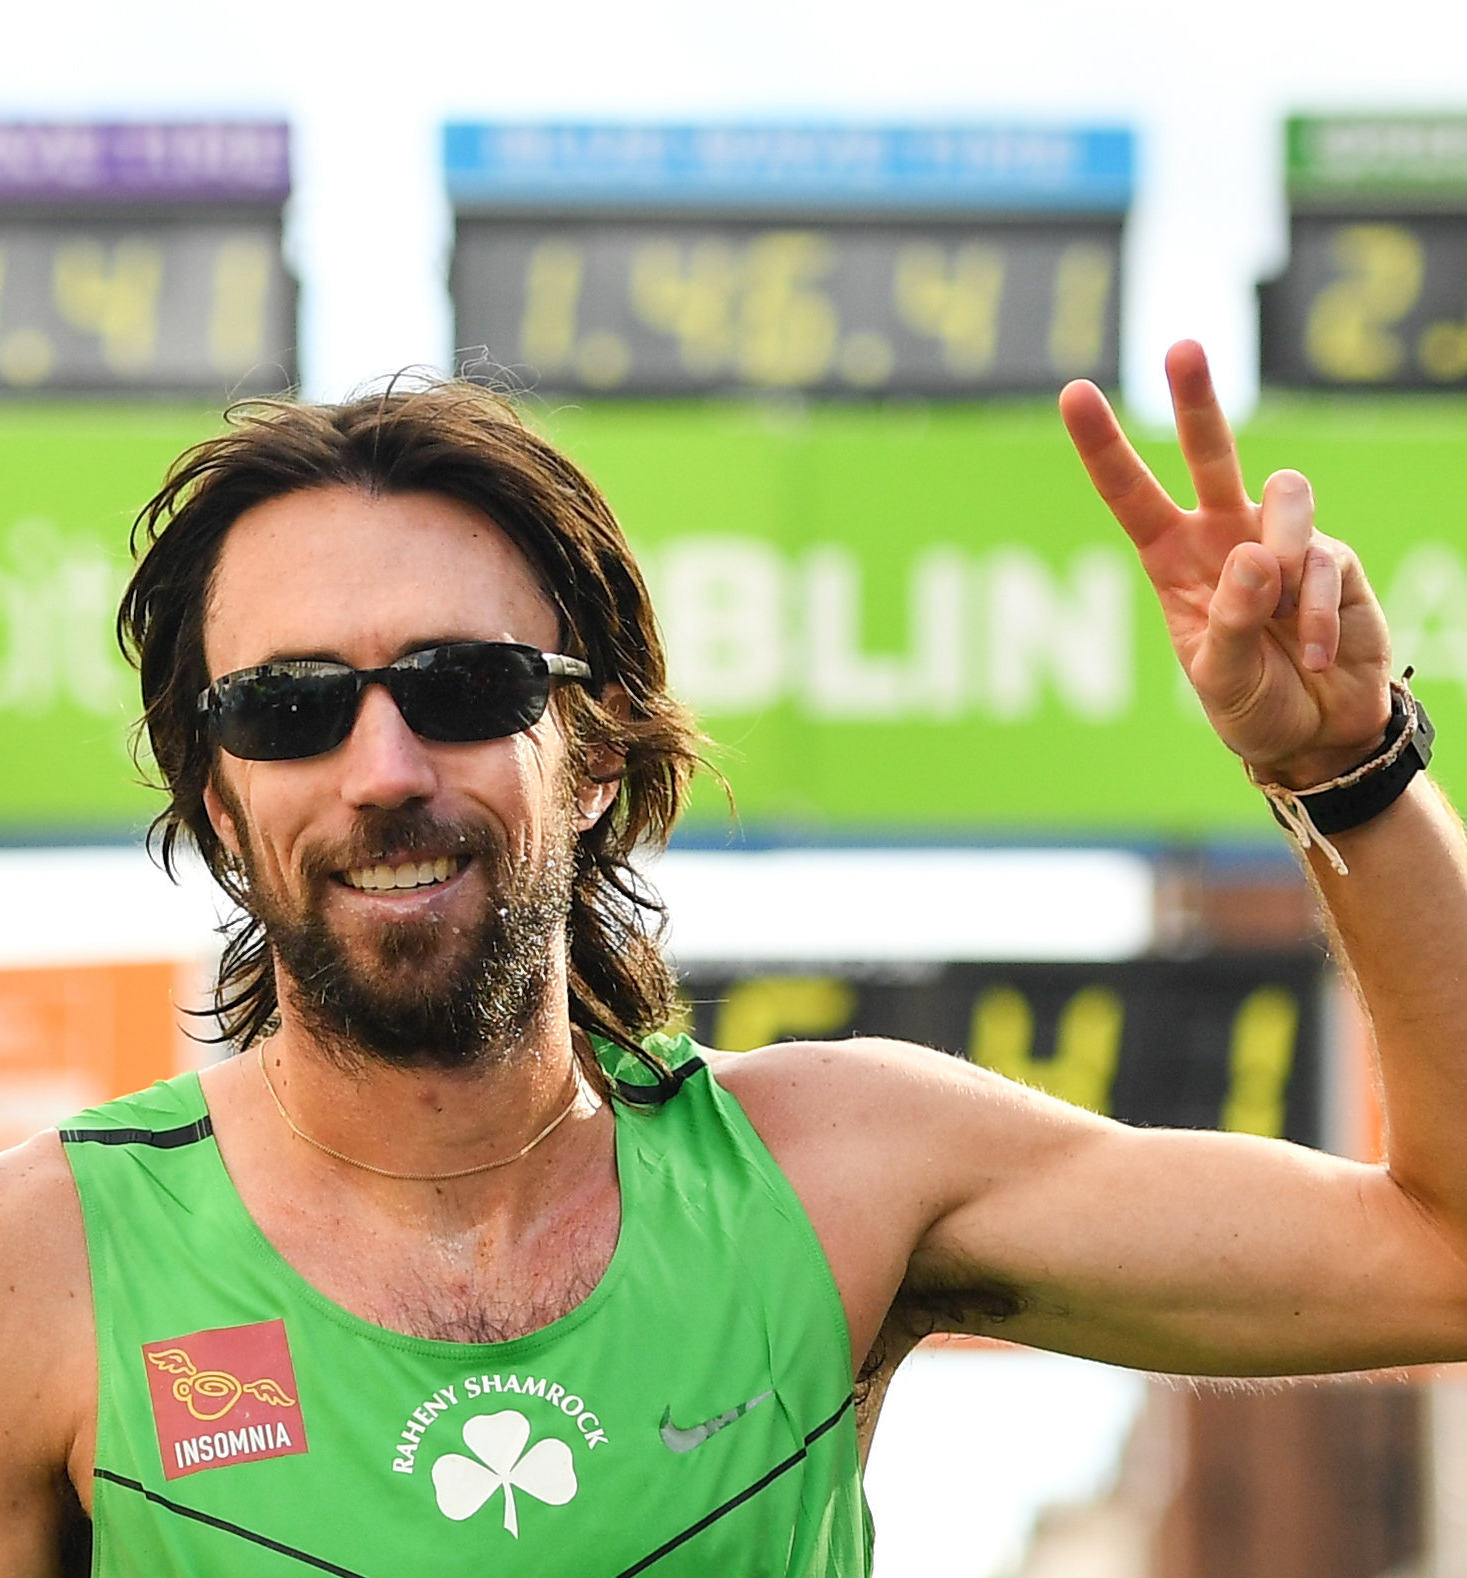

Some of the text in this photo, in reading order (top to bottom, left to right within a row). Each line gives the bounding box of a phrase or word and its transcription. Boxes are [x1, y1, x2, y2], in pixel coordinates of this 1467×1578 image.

[518, 231, 1112, 390] 1.46.41
[642, 532, 1130, 722] BLIN
[173, 1421, 293, 1469] INSOMNIA
[391, 1374, 611, 1475] RAHENY SHAMROCK
